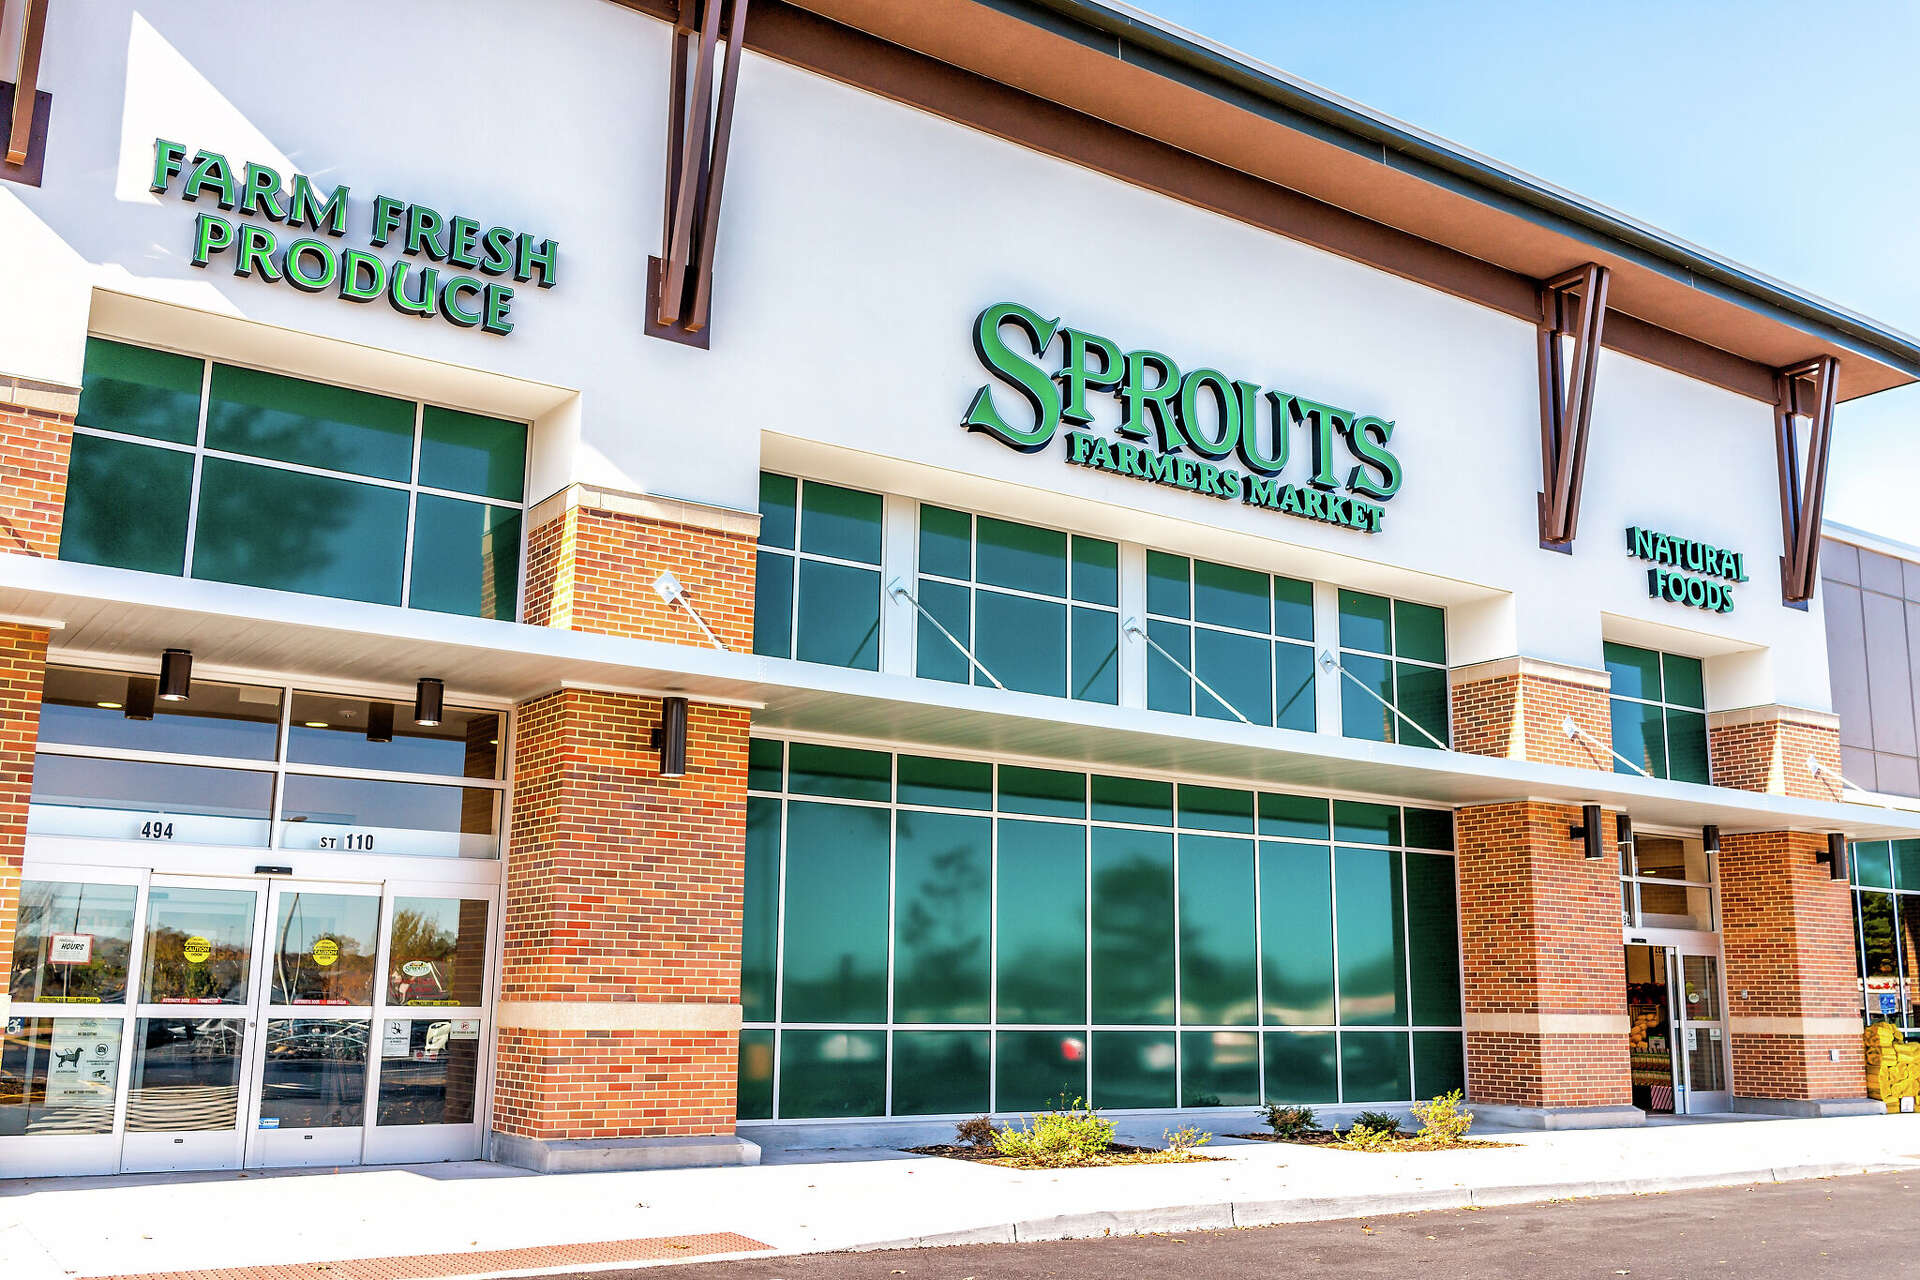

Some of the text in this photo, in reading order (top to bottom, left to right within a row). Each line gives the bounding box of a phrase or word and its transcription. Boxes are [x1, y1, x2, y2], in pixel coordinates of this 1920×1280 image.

[149, 138, 560, 288] FARM FRESH
[190, 212, 516, 336] PRODUCE
[960, 301, 1403, 502] SPROUTS
[1064, 431, 1386, 534] FARMERS MARKET
[1625, 525, 1750, 583] NATURAL
[1647, 567, 1735, 614] FOODS
[141, 821, 174, 840] 494
[320, 833, 374, 851] ST 110
[60, 943, 85, 951] HOURS
